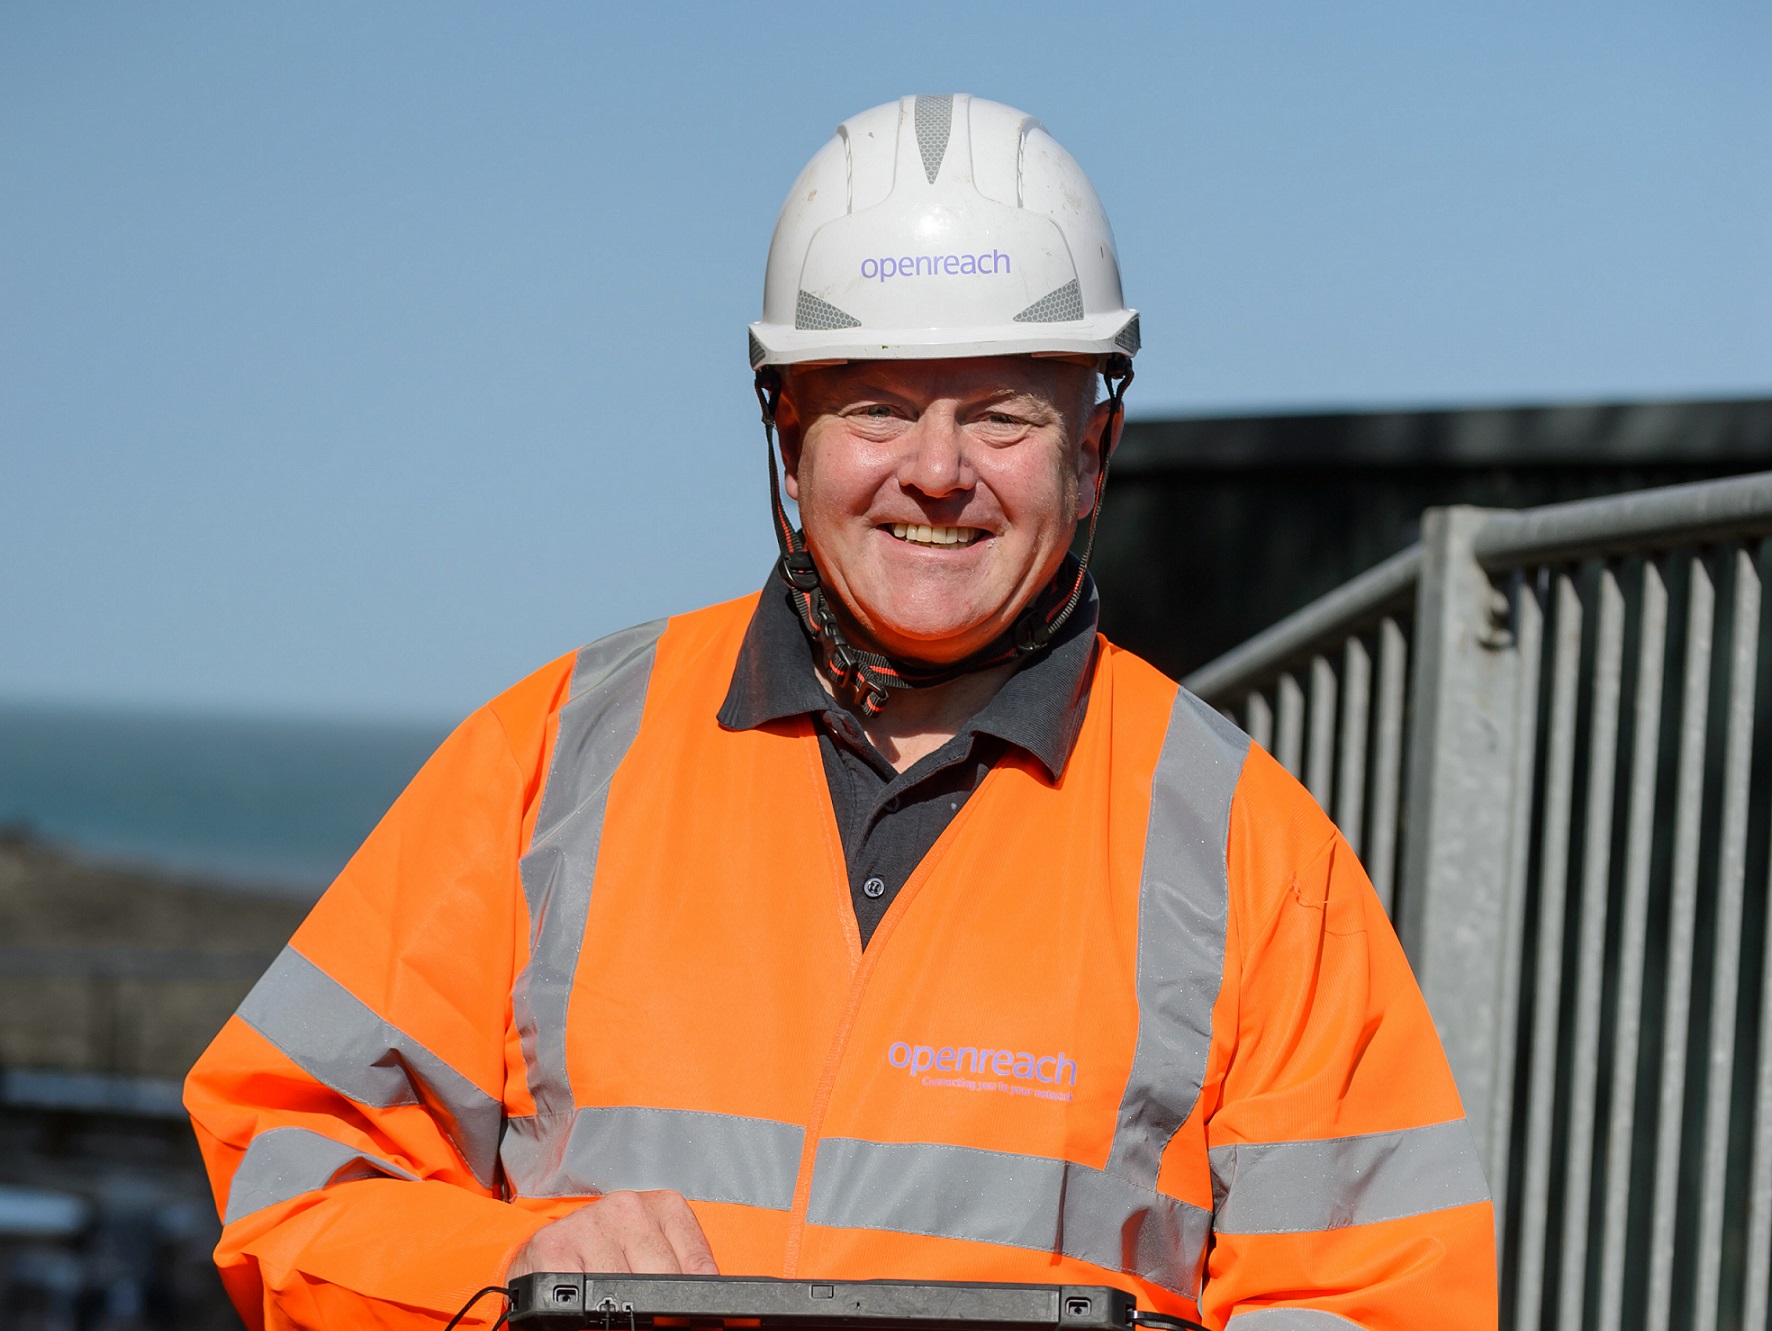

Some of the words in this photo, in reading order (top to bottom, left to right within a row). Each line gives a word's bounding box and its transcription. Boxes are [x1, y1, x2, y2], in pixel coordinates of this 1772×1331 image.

[860, 249, 1011, 283] openreach
[888, 1041, 1077, 1086] openreach
[922, 1076, 976, 1091] Connecting
[977, 1081, 997, 1092] you
[998, 1082, 1009, 1093] to
[1010, 1086, 1033, 1098] your
